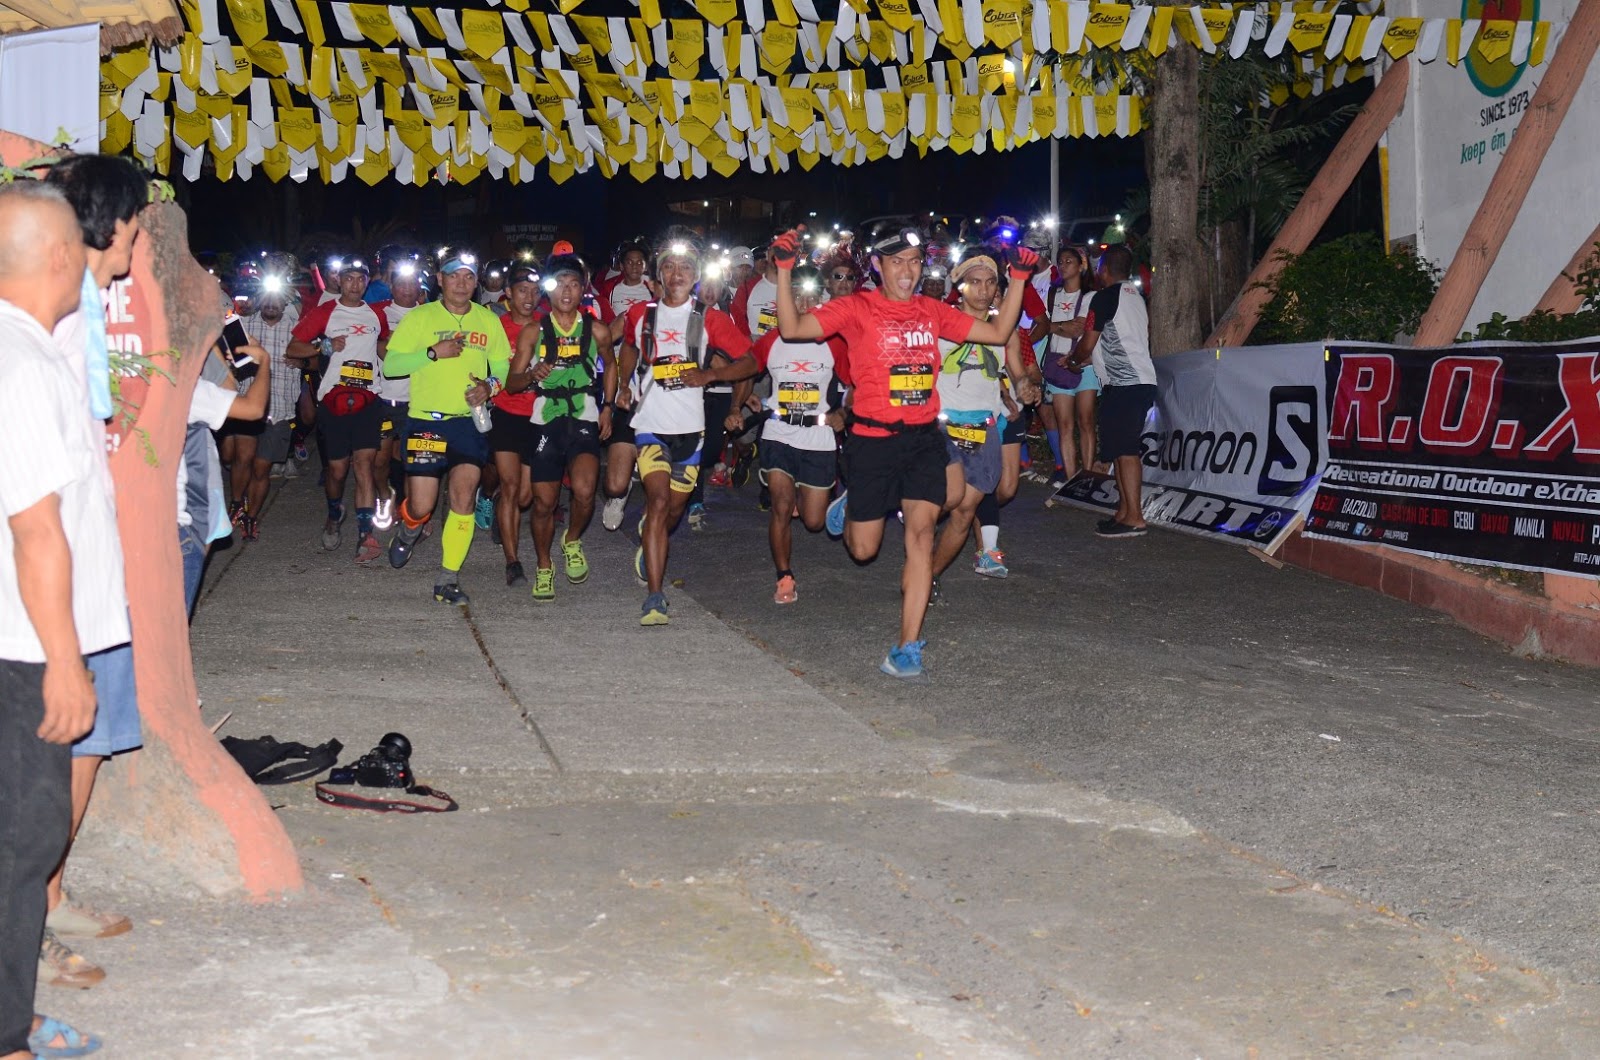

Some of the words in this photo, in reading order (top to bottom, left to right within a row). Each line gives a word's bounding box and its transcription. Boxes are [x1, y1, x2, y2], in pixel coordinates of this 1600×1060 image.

[984, 8, 1020, 24] Cobra
[1089, 12, 1125, 25] Cobra
[1293, 19, 1326, 31] Cobra
[1388, 26, 1417, 38] Cobra
[1483, 28, 1510, 40] Cobra
[979, 63, 1004, 76] Cobra
[903, 73, 926, 87] Cobra
[535, 93, 561, 106] Cobra
[1480, 101, 1506, 127] SINCE
[1508, 90, 1530, 116] 1973
[1460, 140, 1486, 165] keep
[903, 330, 934, 348] 100
[351, 367, 366, 378] 133
[903, 375, 925, 388] 154
[790, 391, 808, 401] 120
[415, 439, 435, 451] 036
[1323, 463, 1440, 489] Recreational
[1441, 473, 1532, 498] Outdoor
[1453, 510, 1475, 531] CEBU
[1480, 513, 1510, 535] DAVAO
[1513, 517, 1545, 539] MANILA
[1552, 520, 1585, 543] NUVALI
